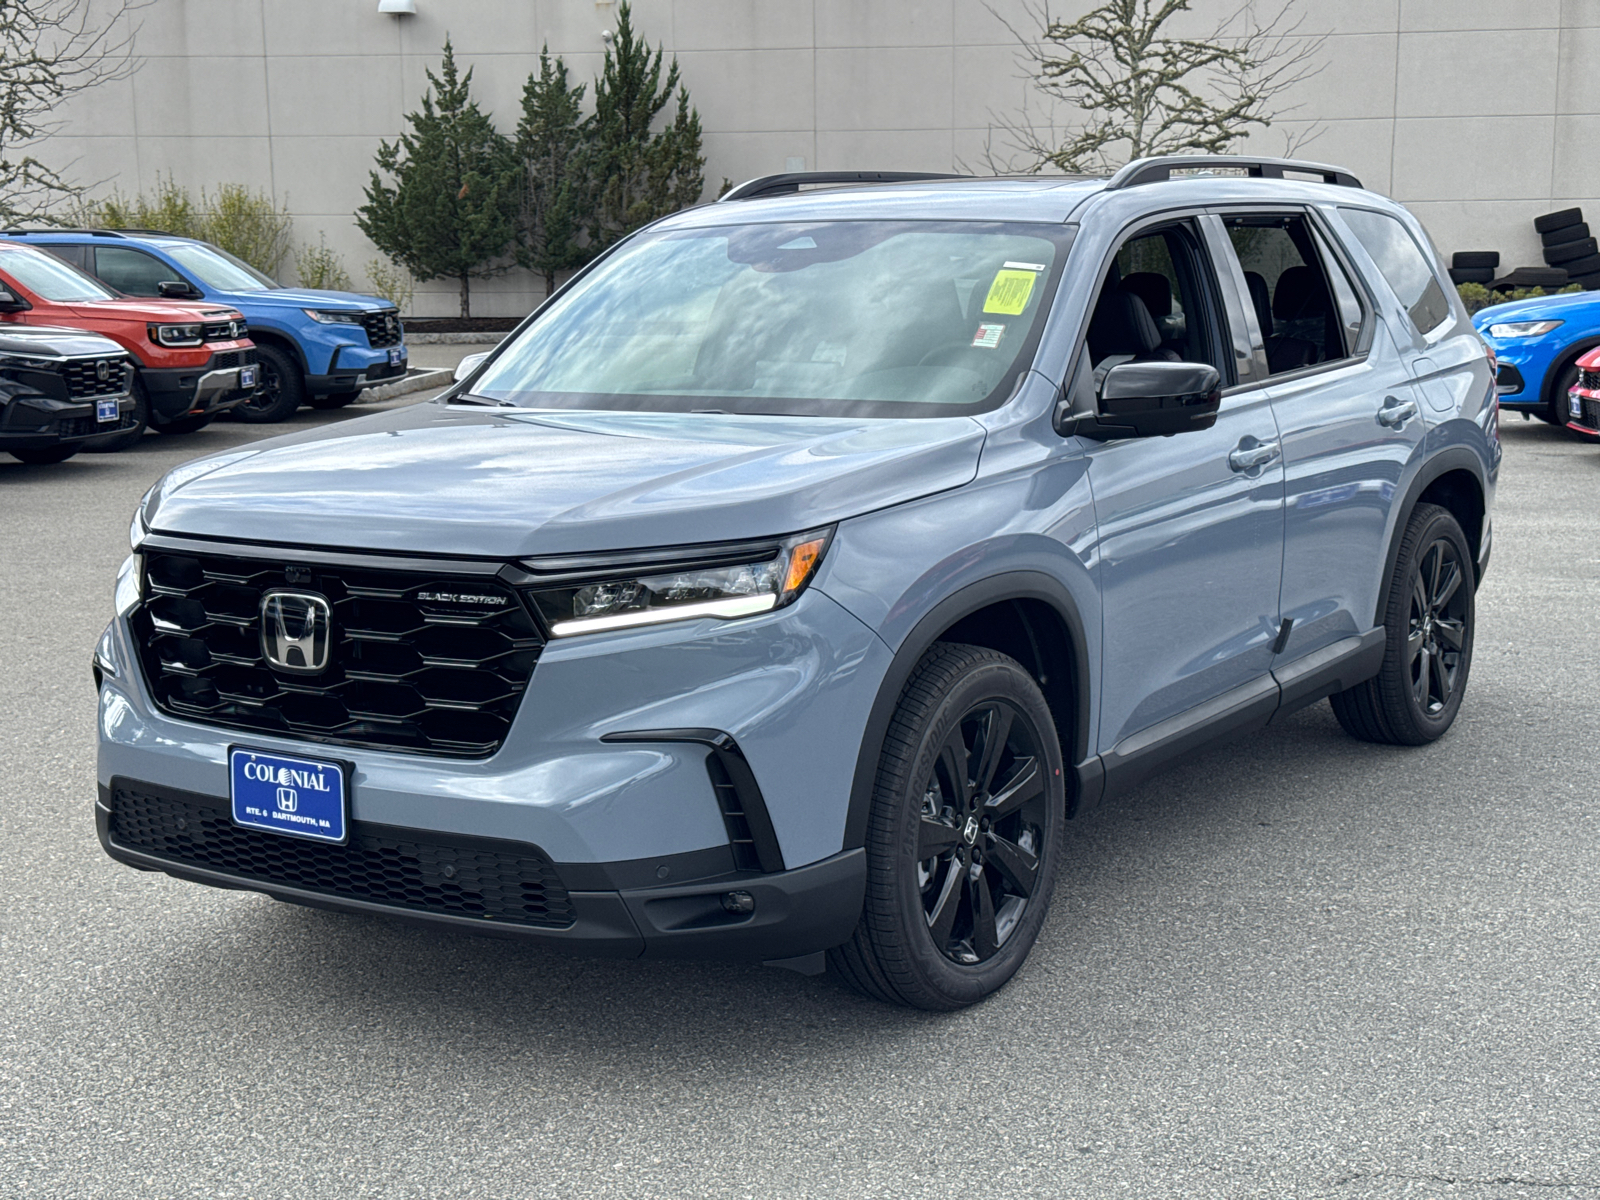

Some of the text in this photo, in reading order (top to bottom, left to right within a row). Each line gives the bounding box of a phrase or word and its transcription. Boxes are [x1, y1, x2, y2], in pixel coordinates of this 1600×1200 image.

[417, 592, 507, 605] BLACK EDITION
[244, 762, 330, 792] COLONIAL
[902, 707, 951, 858] BRIDGESTONE
[262, 809, 268, 817] 6
[272, 811, 318, 827] DARTMOUTH,
[319, 819, 331, 828] MA
